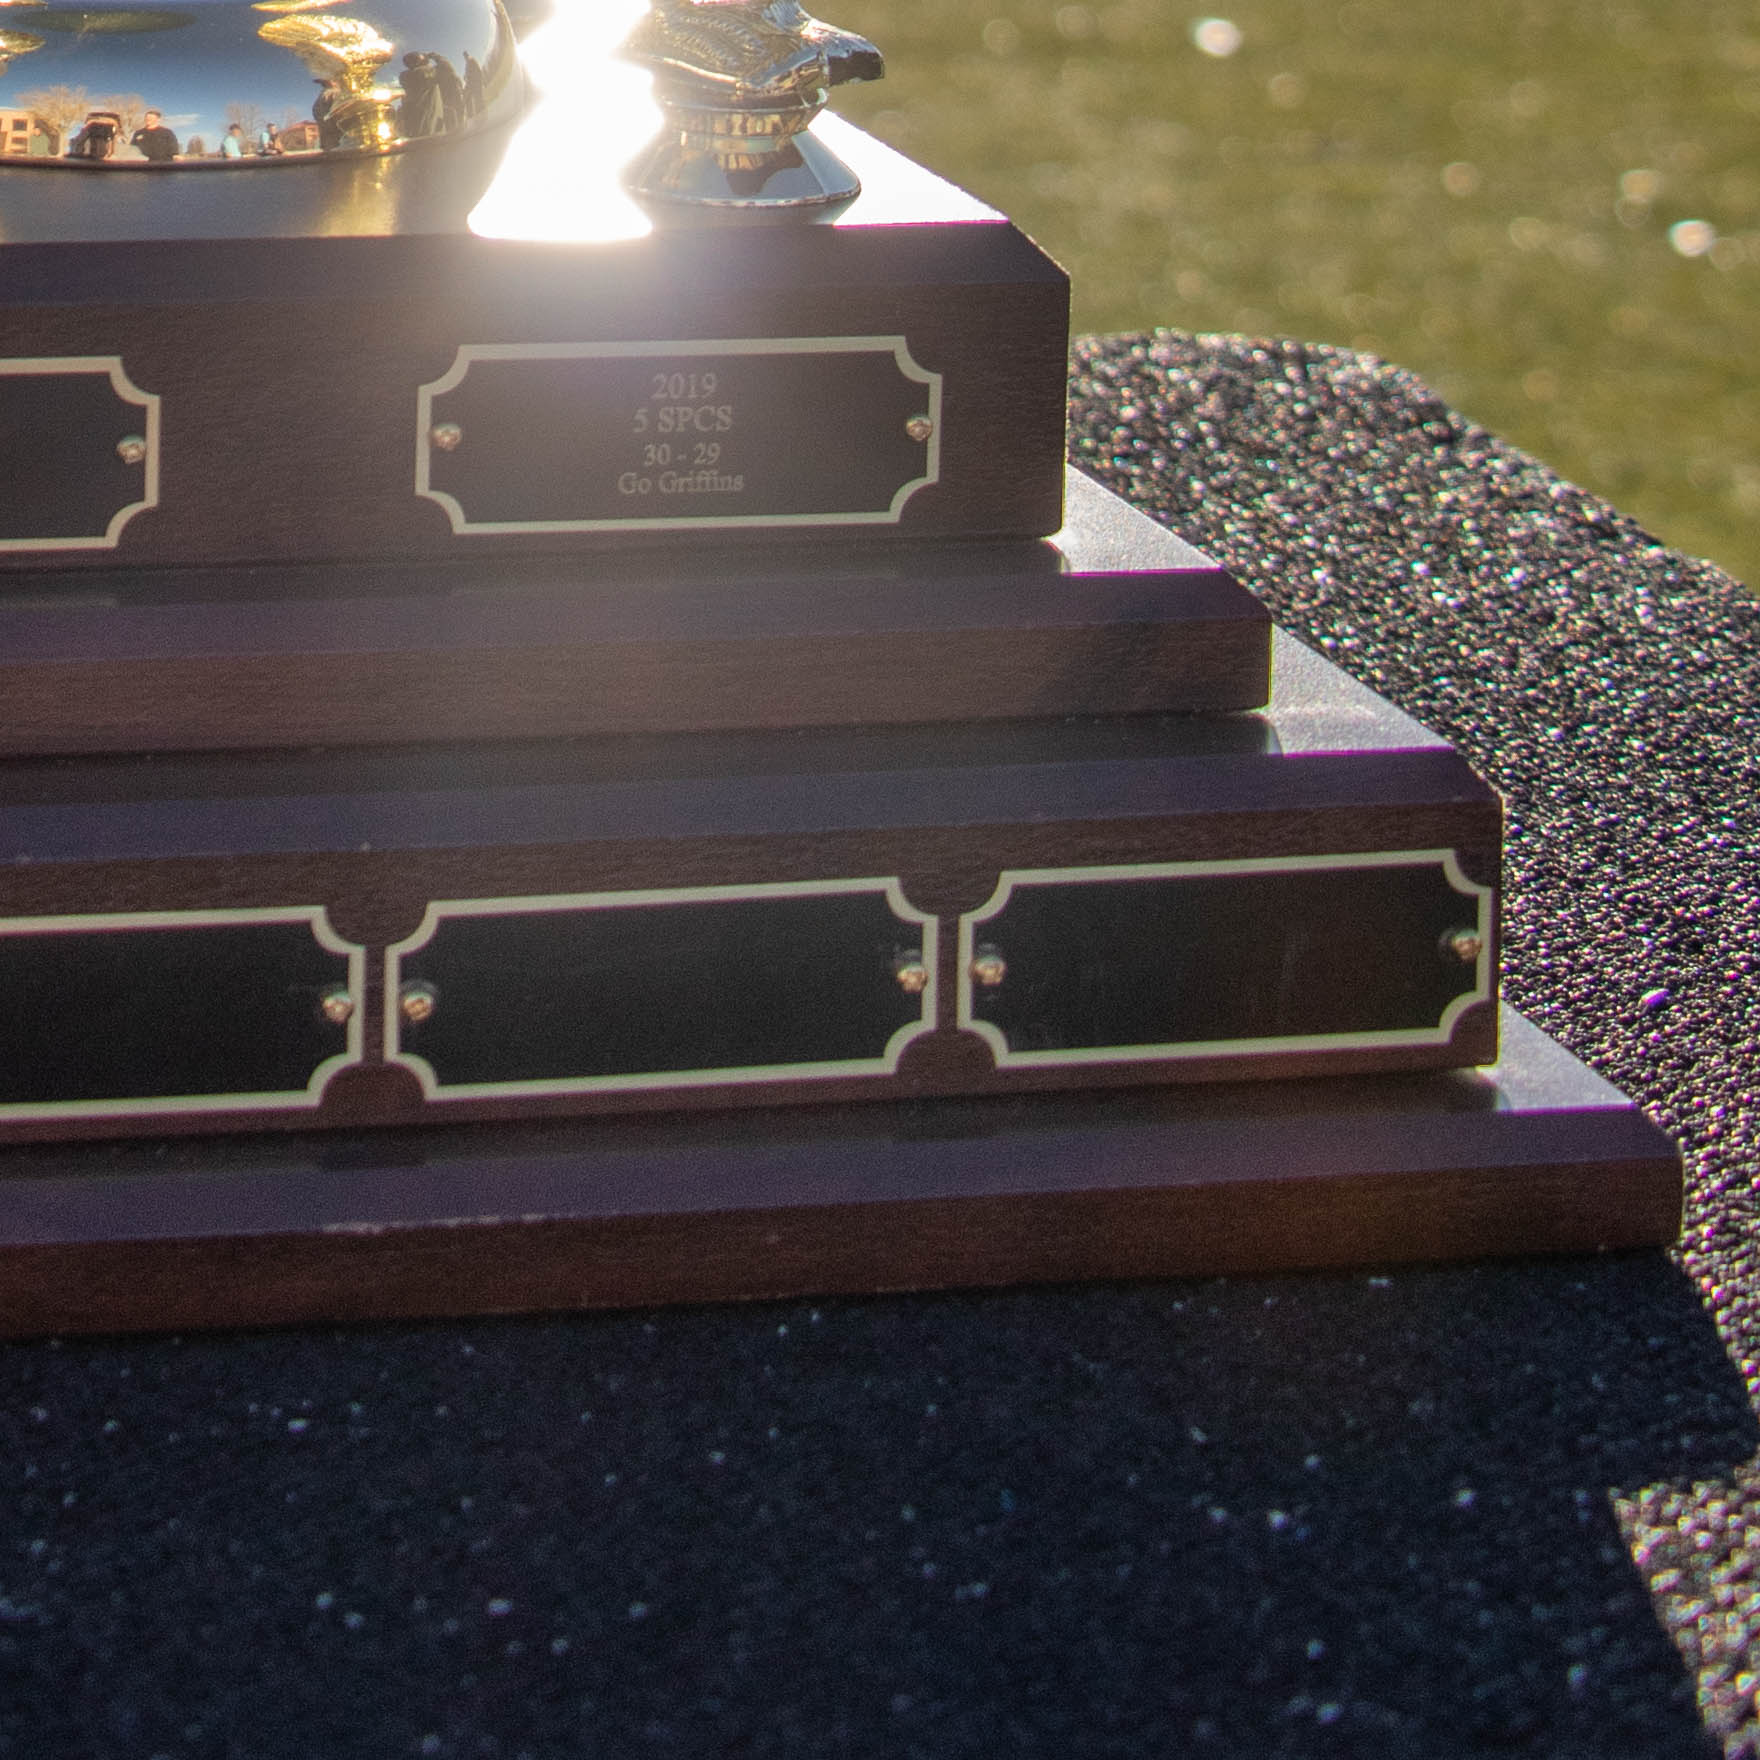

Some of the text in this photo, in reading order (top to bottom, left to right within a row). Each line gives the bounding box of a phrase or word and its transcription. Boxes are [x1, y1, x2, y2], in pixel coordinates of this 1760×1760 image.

[650, 372, 718, 400] 2019
[632, 405, 734, 433] 5 SPCS
[643, 443, 672, 467] 30
[693, 442, 722, 465] 29
[618, 469, 745, 495] Go Griffins
